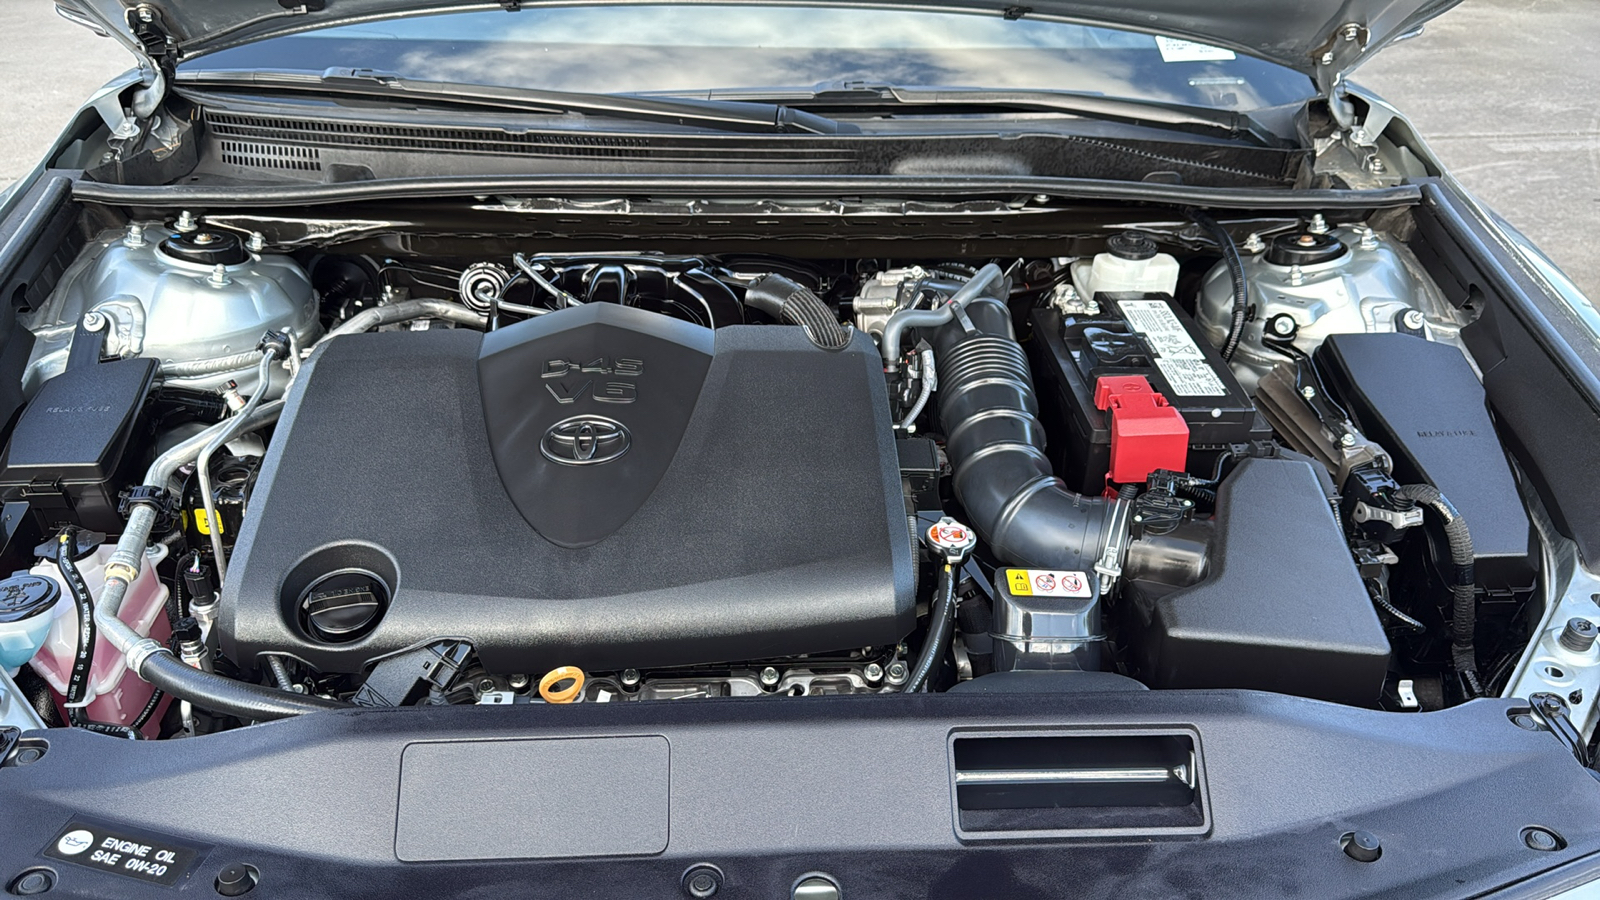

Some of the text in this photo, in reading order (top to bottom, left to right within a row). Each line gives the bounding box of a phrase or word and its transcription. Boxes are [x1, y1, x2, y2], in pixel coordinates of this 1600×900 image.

[545, 379, 637, 404] V6
[90, 850, 167, 876] SAE 0W-20
[101, 837, 176, 864] ENGINE OIL
